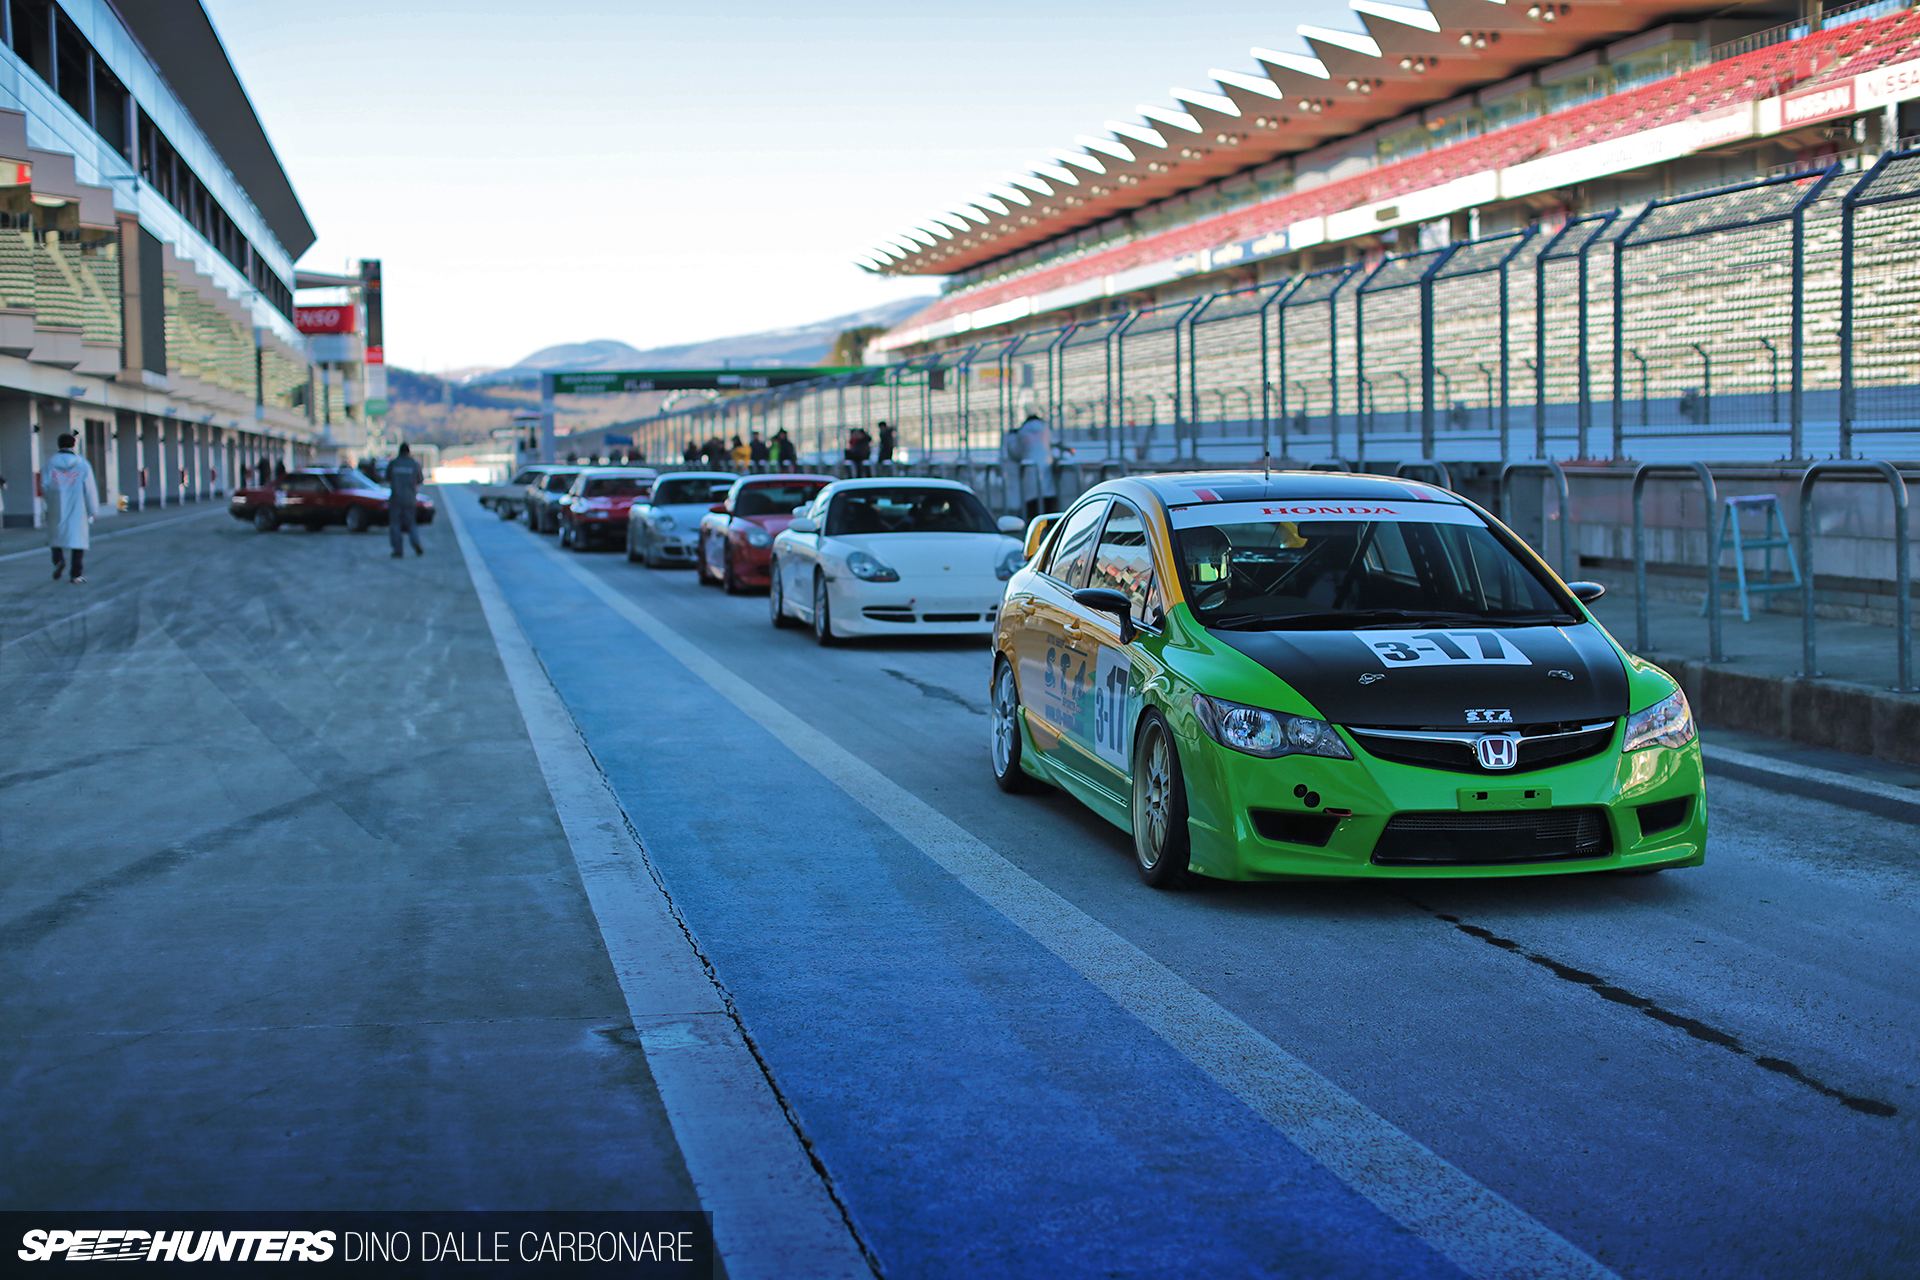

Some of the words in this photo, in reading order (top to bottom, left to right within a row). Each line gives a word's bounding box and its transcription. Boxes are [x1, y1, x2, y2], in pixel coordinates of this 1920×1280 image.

[1262, 507, 1400, 515] HONDA
[1374, 632, 1505, 661] 3-17
[1096, 665, 1128, 755] 3-17
